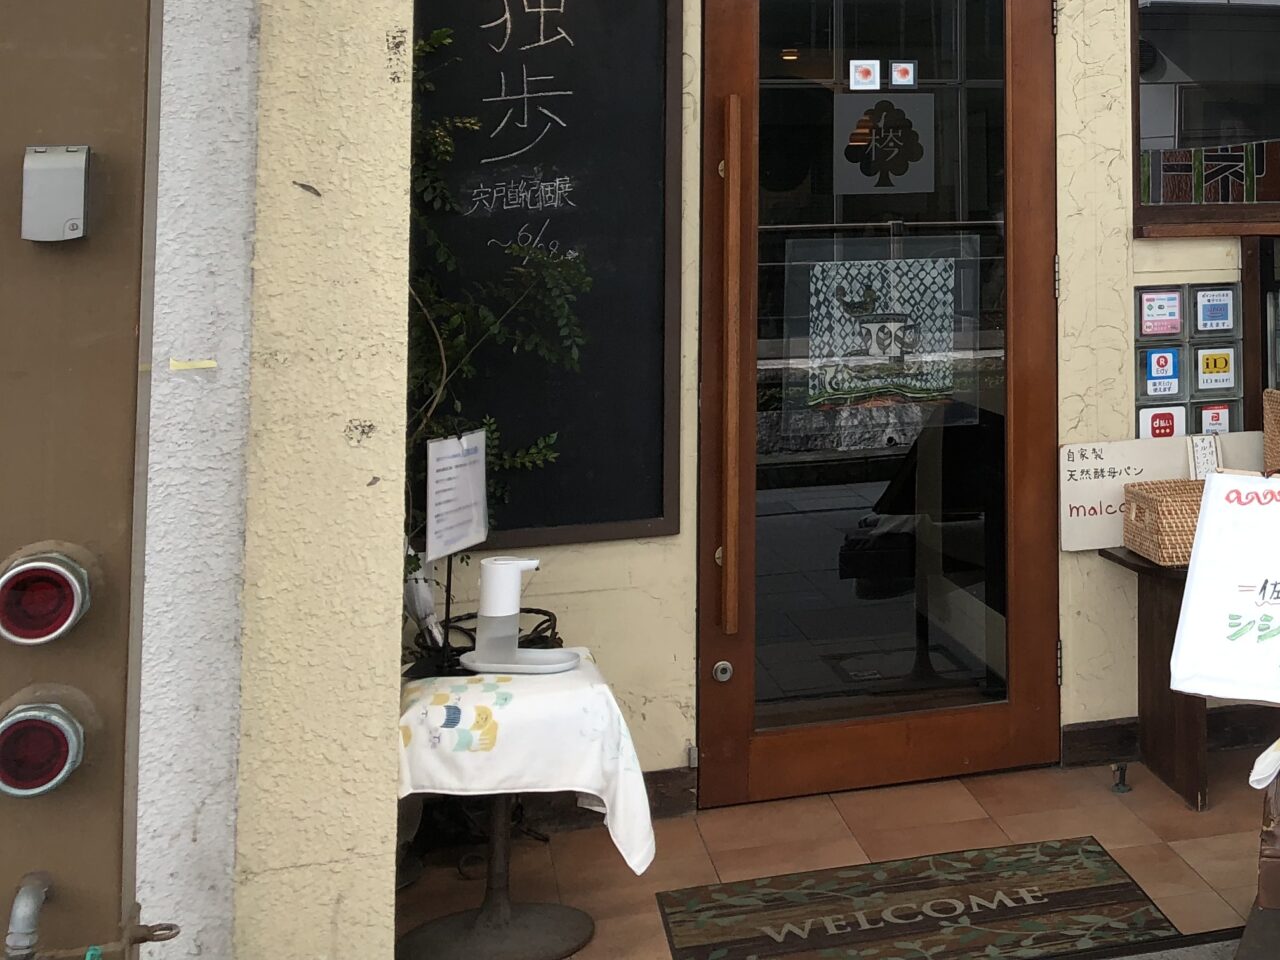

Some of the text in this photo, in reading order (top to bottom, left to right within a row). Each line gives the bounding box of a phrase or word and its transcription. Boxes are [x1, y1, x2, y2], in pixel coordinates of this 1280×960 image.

[1205, 357, 1229, 369] iD
[1153, 419, 1173, 427] d払い
[1066, 448, 1104, 463] 自家製
[1066, 466, 1144, 482] 天然酵母パン
[761, 886, 1049, 944] WELCOME
